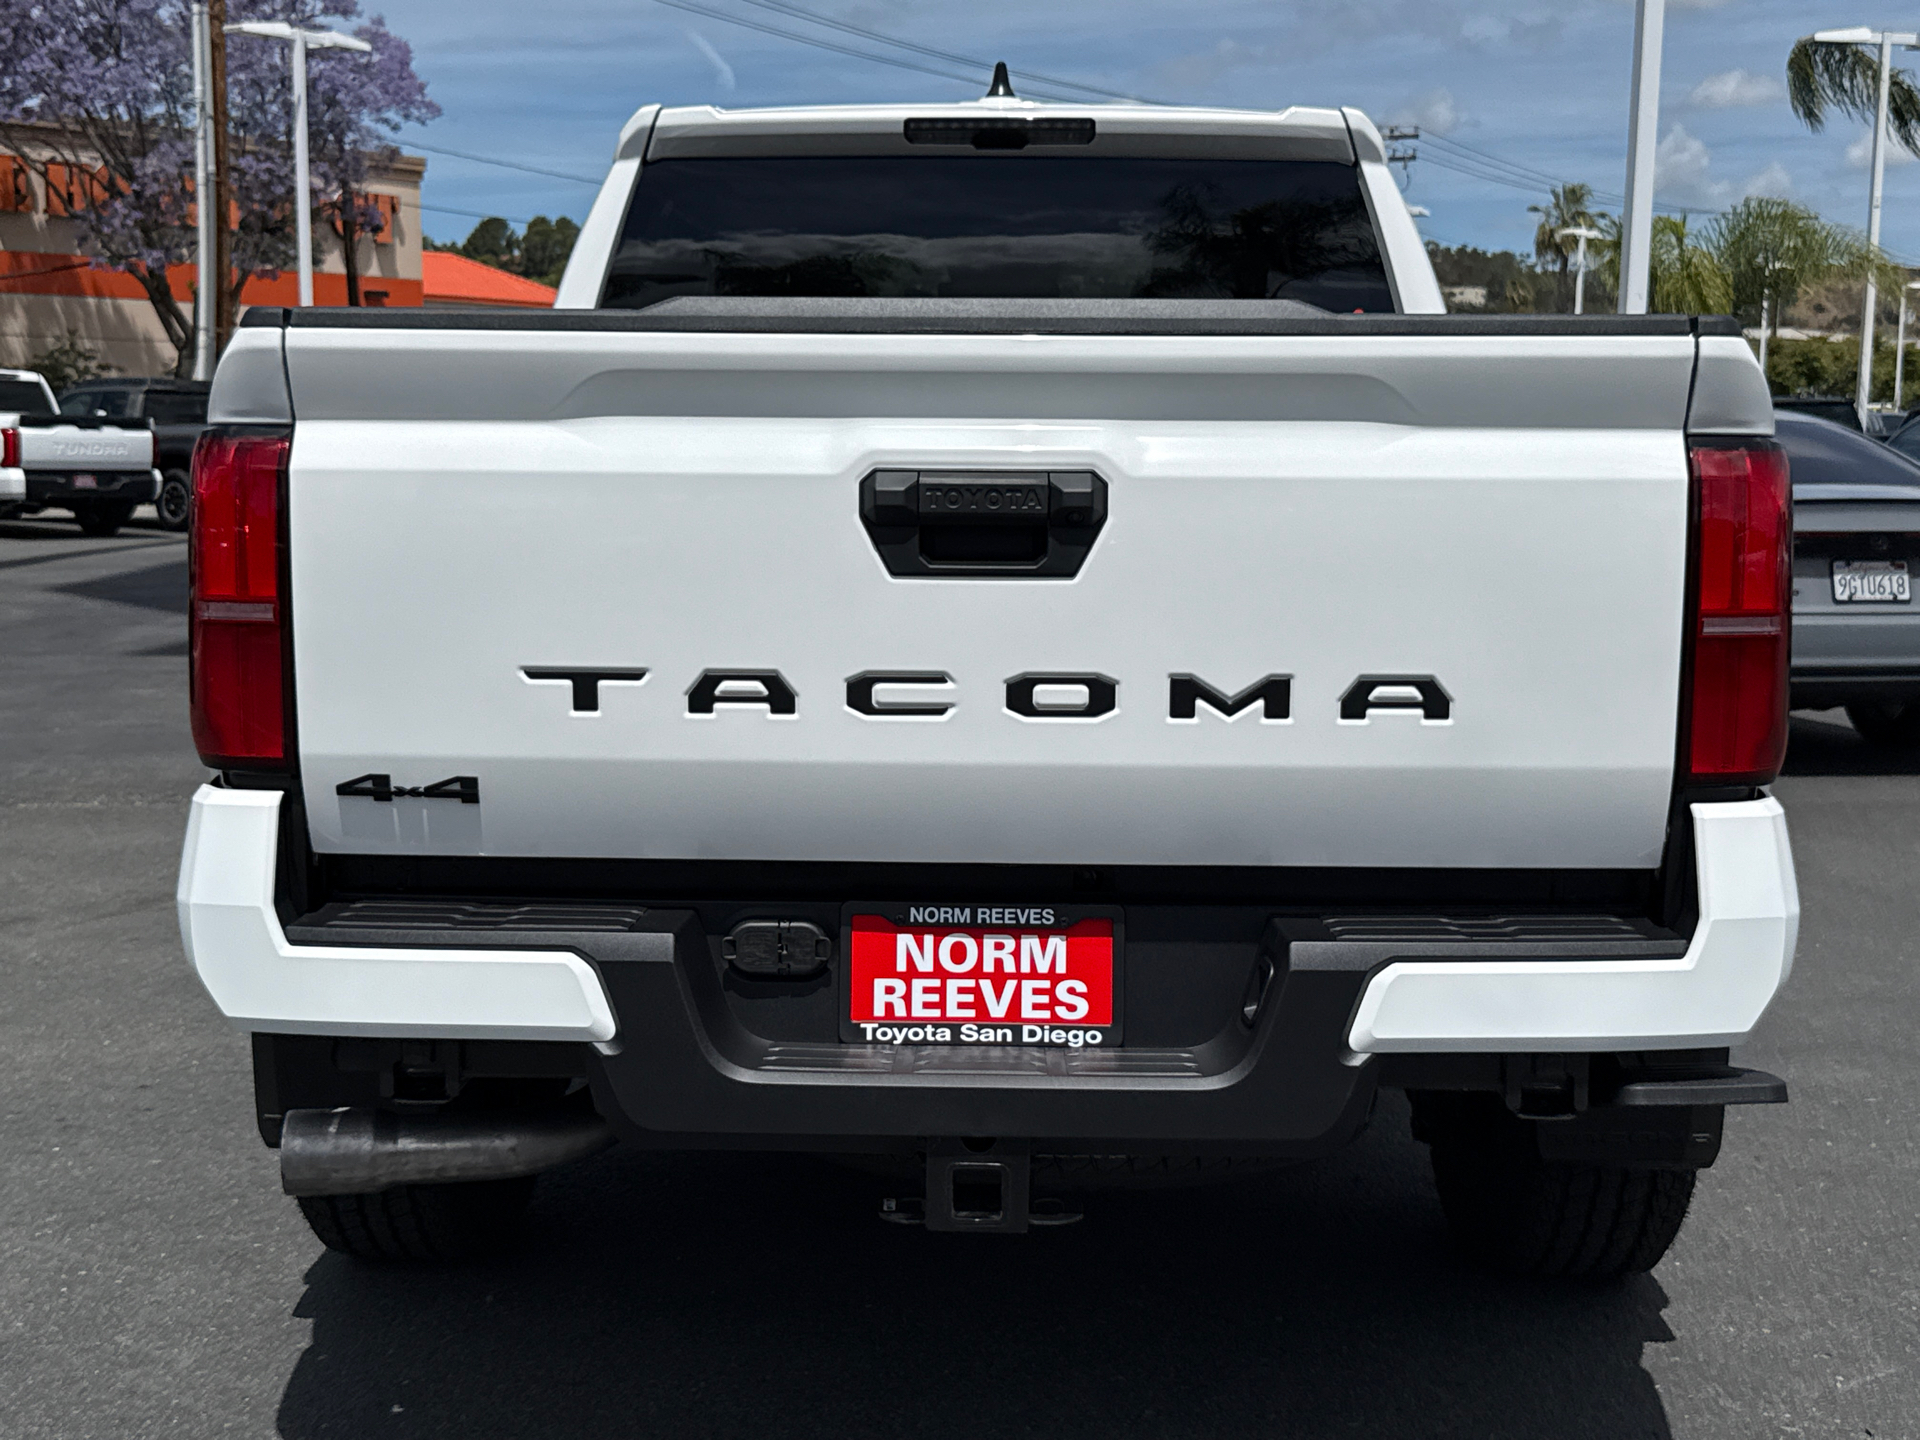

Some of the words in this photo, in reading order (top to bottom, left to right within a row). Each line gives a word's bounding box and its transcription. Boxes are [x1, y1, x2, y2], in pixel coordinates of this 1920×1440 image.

[53, 442, 128, 456] TUNDRA
[925, 488, 1042, 510] TOYOTA
[1838, 573, 1906, 595] 9GTU618
[518, 666, 1454, 725] TACOMA
[910, 907, 970, 924] NORM
[977, 909, 1055, 925] REEVES
[896, 933, 1067, 974] NORM
[873, 978, 1089, 1020] REEVES
[860, 1023, 951, 1045] Toyota
[960, 1024, 1012, 1043] San
[1022, 1025, 1103, 1048] Diego
